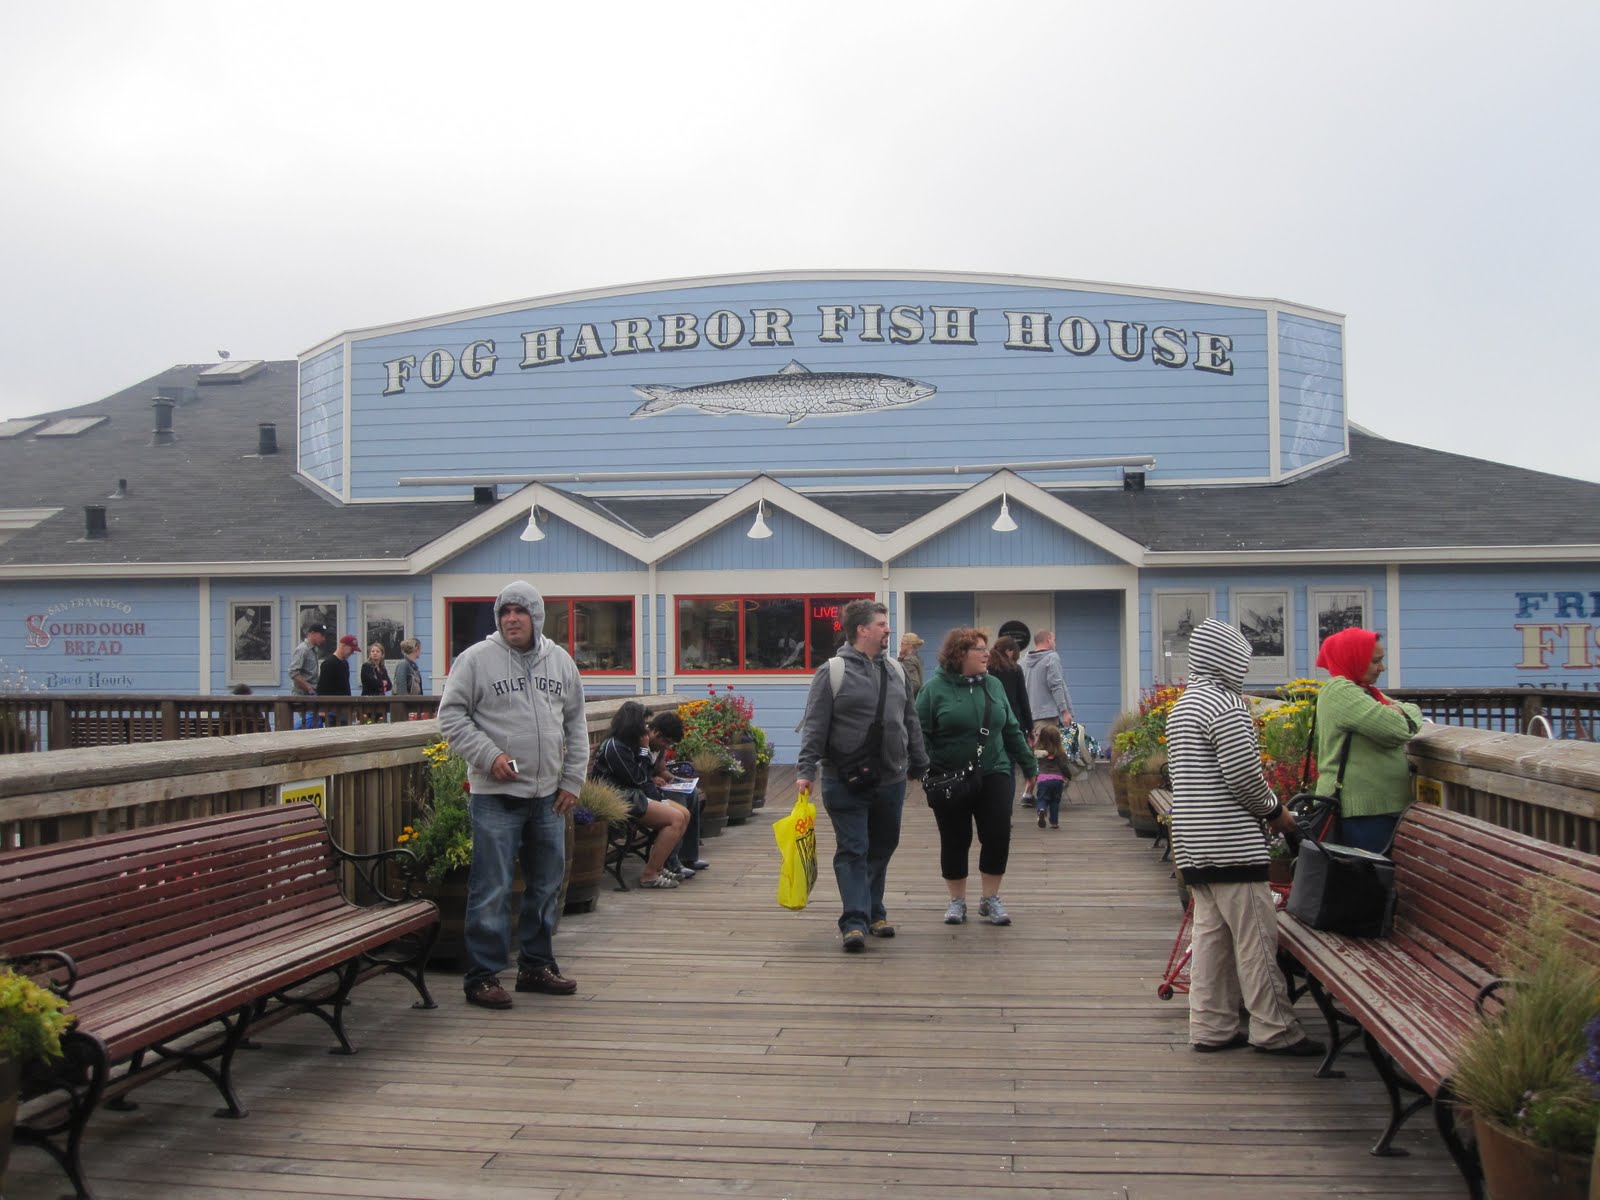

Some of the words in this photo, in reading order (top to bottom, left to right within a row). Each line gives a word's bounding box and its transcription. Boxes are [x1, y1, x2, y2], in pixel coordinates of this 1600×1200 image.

[382, 338, 498, 397] FOG
[519, 308, 795, 370] HARBOR
[817, 304, 978, 346] FISH
[1003, 310, 1235, 376] HOUSE
[47, 602, 69, 616] SAN
[69, 598, 132, 614] FRANCISCO
[813, 606, 839, 618] LIVE
[25, 614, 145, 648] SOURDOUGH
[64, 640, 123, 655] BREAD
[1514, 623, 1600, 670] FI
[88, 672, 133, 688] Hourly
